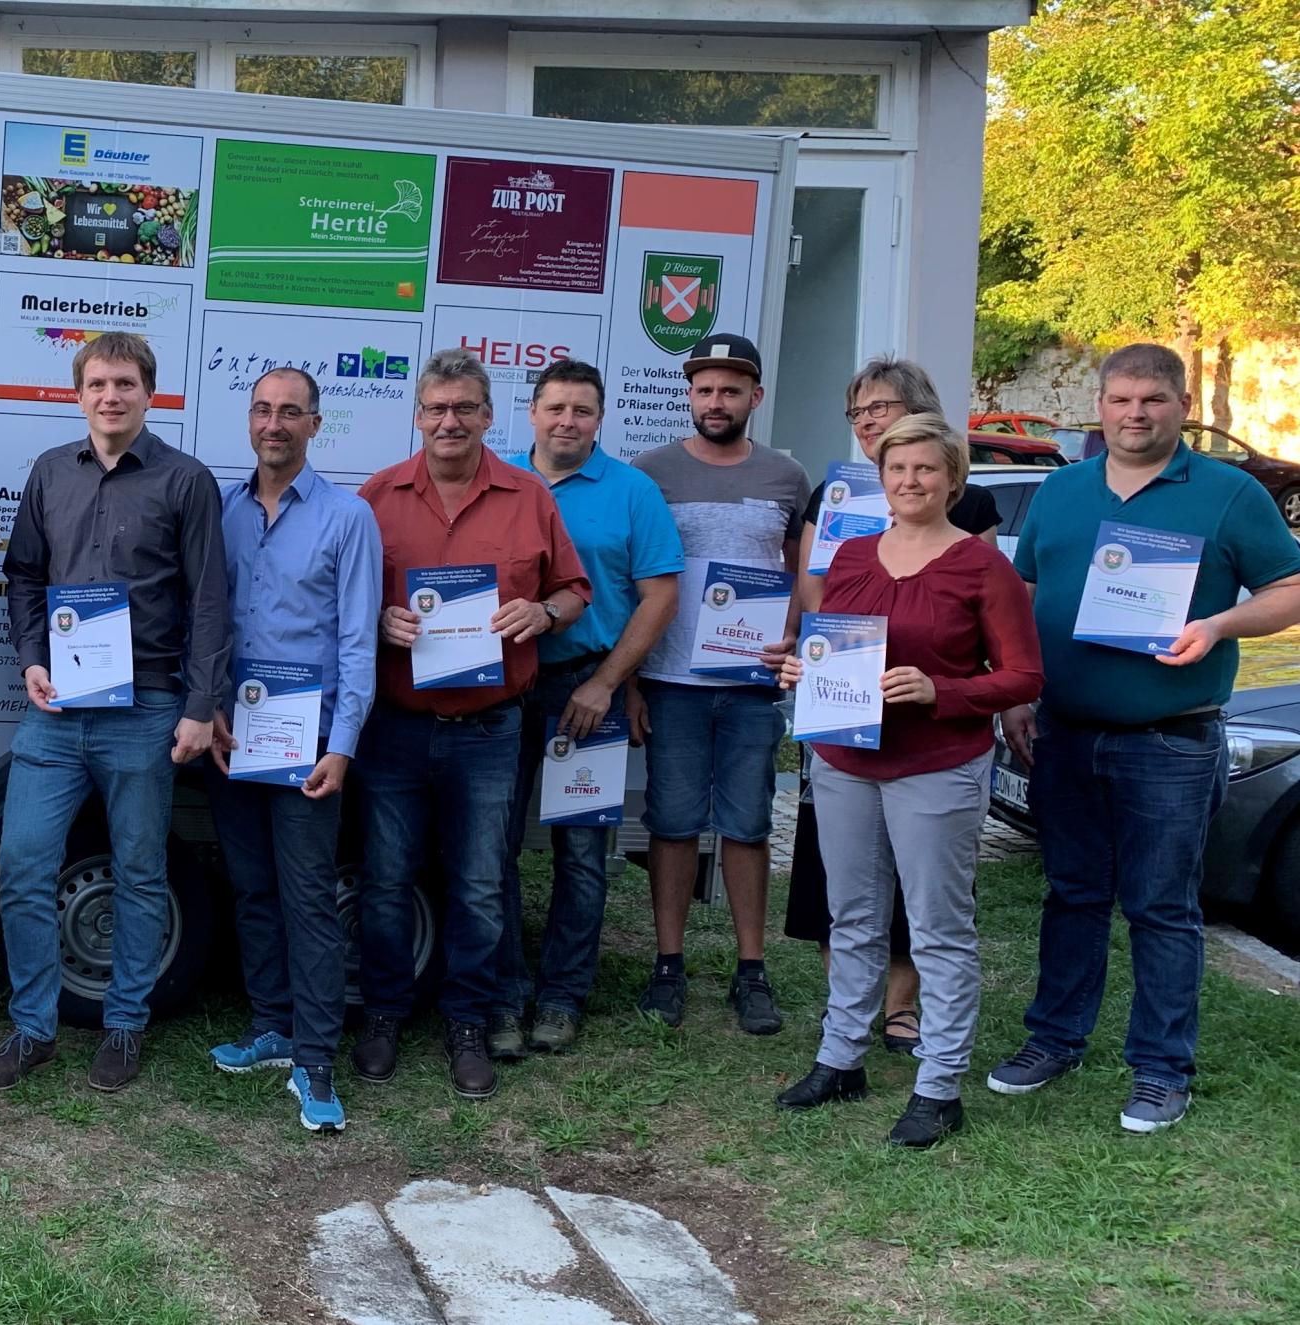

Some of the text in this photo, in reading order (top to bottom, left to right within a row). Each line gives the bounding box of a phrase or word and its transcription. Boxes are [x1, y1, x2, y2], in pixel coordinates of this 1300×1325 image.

[94, 149, 150, 163] Däubler
[299, 196, 375, 212] Schreinerei
[491, 189, 566, 213] ZUR POST
[86, 203, 102, 215] Wir
[511, 210, 544, 218] RESTAURANT
[74, 215, 130, 230] Lebensmittel.
[311, 211, 388, 235] Hertle
[311, 232, 386, 244] Mein Schreinermeister
[21, 294, 148, 318] Malerbetrieb
[111, 320, 131, 328] GEORG
[653, 323, 702, 338] Oettingen
[460, 335, 571, 368] HEISS
[621, 366, 688, 380] Der Volkstra
[623, 382, 692, 398] Erhaltungsv
[666, 401, 690, 412] Oett
[322, 423, 350, 434] 2676
[623, 415, 690, 429] e.V. bedankt
[625, 430, 667, 443] herzlich
[716, 626, 764, 642] LEBERLE
[816, 676, 850, 689] Physio
[816, 686, 871, 704] Wittich
[564, 785, 601, 794] BITTNER
